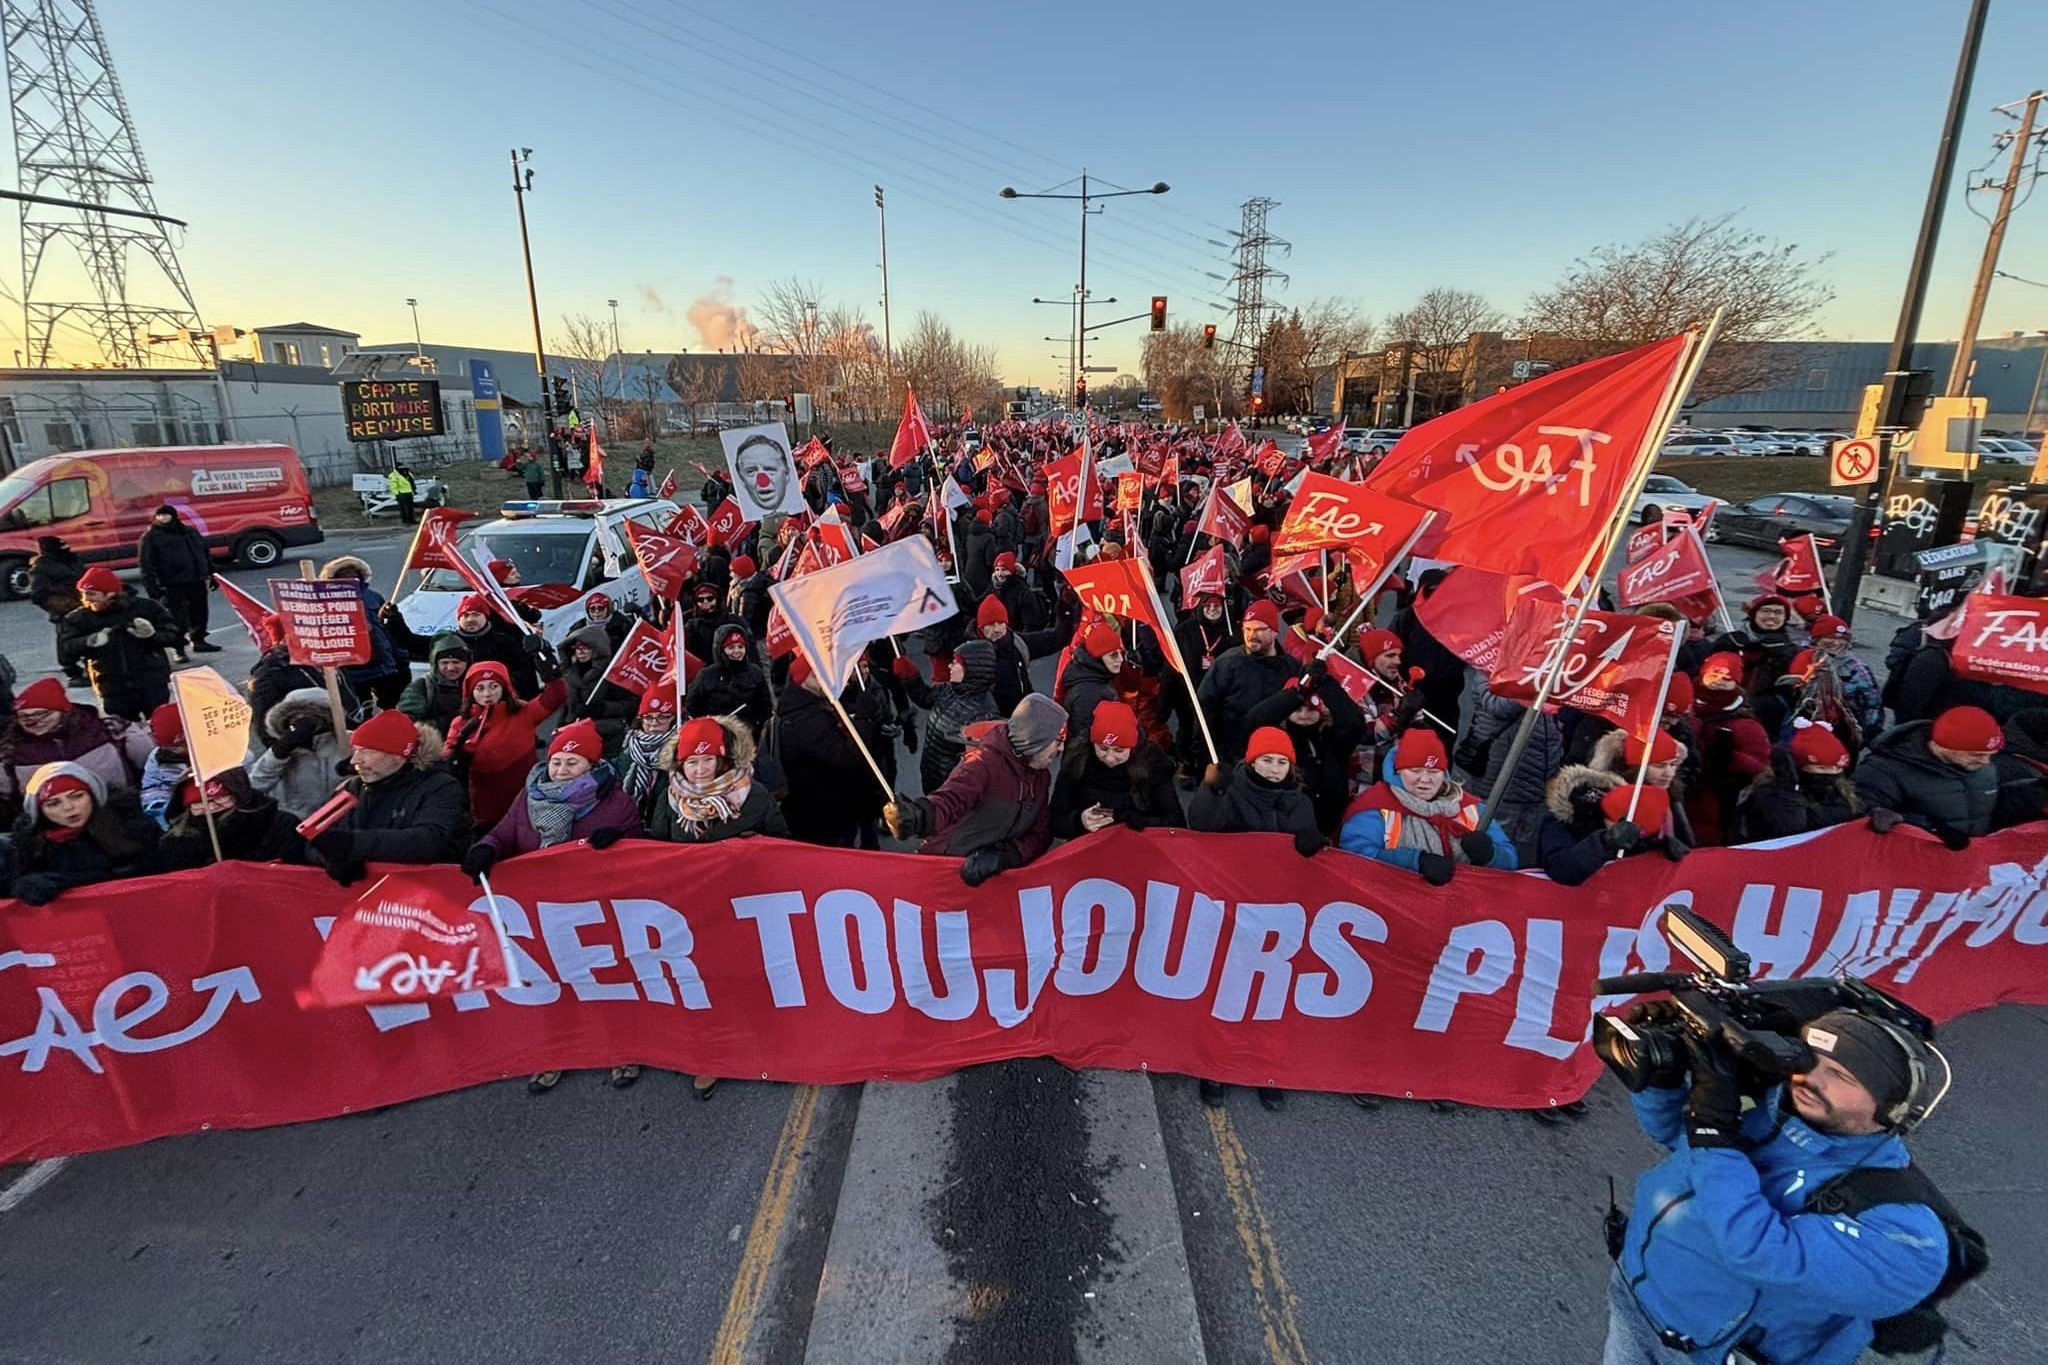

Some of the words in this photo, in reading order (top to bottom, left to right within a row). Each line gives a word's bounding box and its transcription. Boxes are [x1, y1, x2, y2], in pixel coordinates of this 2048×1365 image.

[358, 383, 418, 398] CARTE
[352, 400, 429, 417] PORTUAIRE
[1918, 543, 1979, 565] L'ÉDUCATION
[1939, 566, 1967, 581] DANS
[282, 601, 326, 612] DEHORS
[327, 601, 357, 612] POUR
[294, 613, 350, 625] PROTÉGER
[294, 626, 320, 637] MON
[322, 625, 357, 637] ÉCOLE
[1968, 655, 2041, 672] Fédération
[313, 895, 711, 1033] SER
[730, 878, 1388, 1029] TOUJOURS
[0, 950, 208, 1073] Ae
